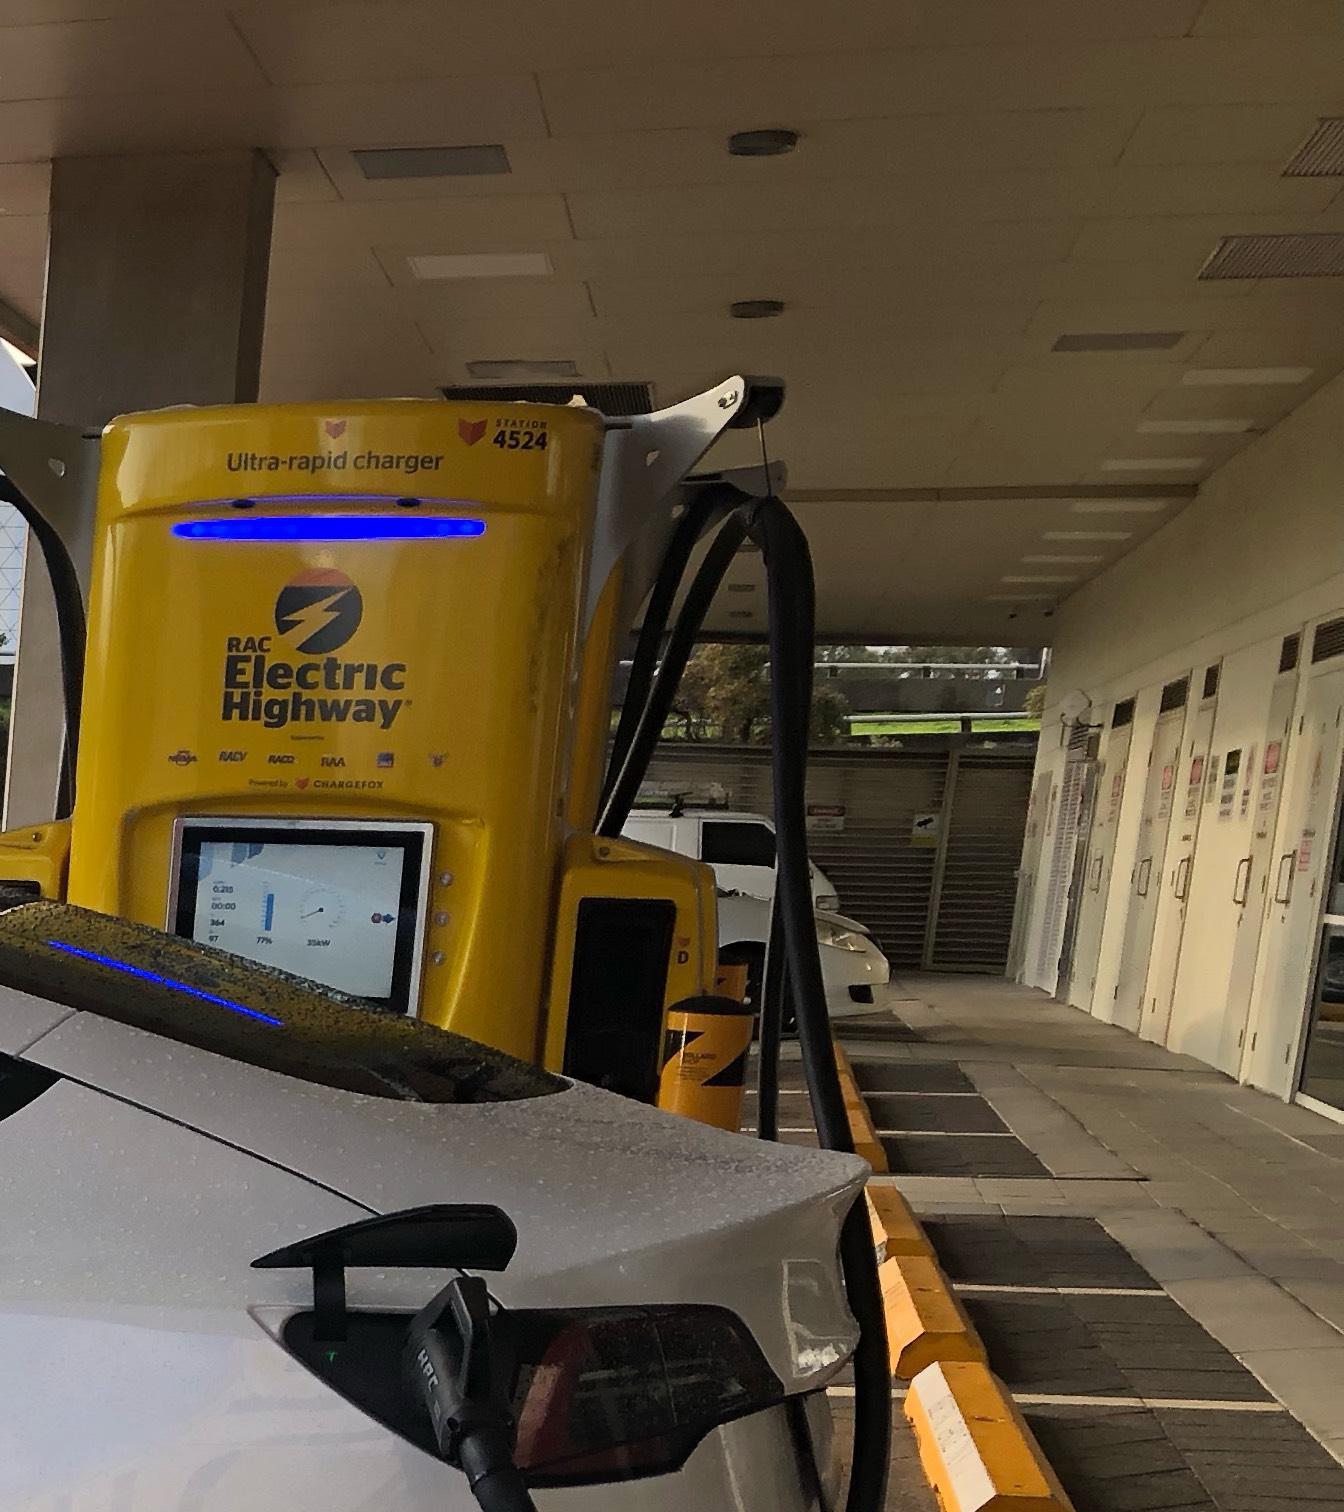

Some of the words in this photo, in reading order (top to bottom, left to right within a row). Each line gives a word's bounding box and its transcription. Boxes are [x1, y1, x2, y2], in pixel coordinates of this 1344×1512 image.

[495, 418, 548, 429] STATION
[493, 430, 548, 450] 4524
[226, 451, 346, 474] Ultra-rapid
[353, 451, 444, 474] charger
[227, 636, 272, 653] RAC
[224, 654, 407, 691] Electric
[221, 690, 404, 730] Highway
[218, 750, 247, 763] RACV
[320, 756, 346, 768] RAA
[249, 778, 275, 789] Powered
[277, 779, 289, 790] by
[313, 779, 385, 790] CHARGEFOX
[256, 936, 273, 945] 77%
[676, 950, 689, 964] D
